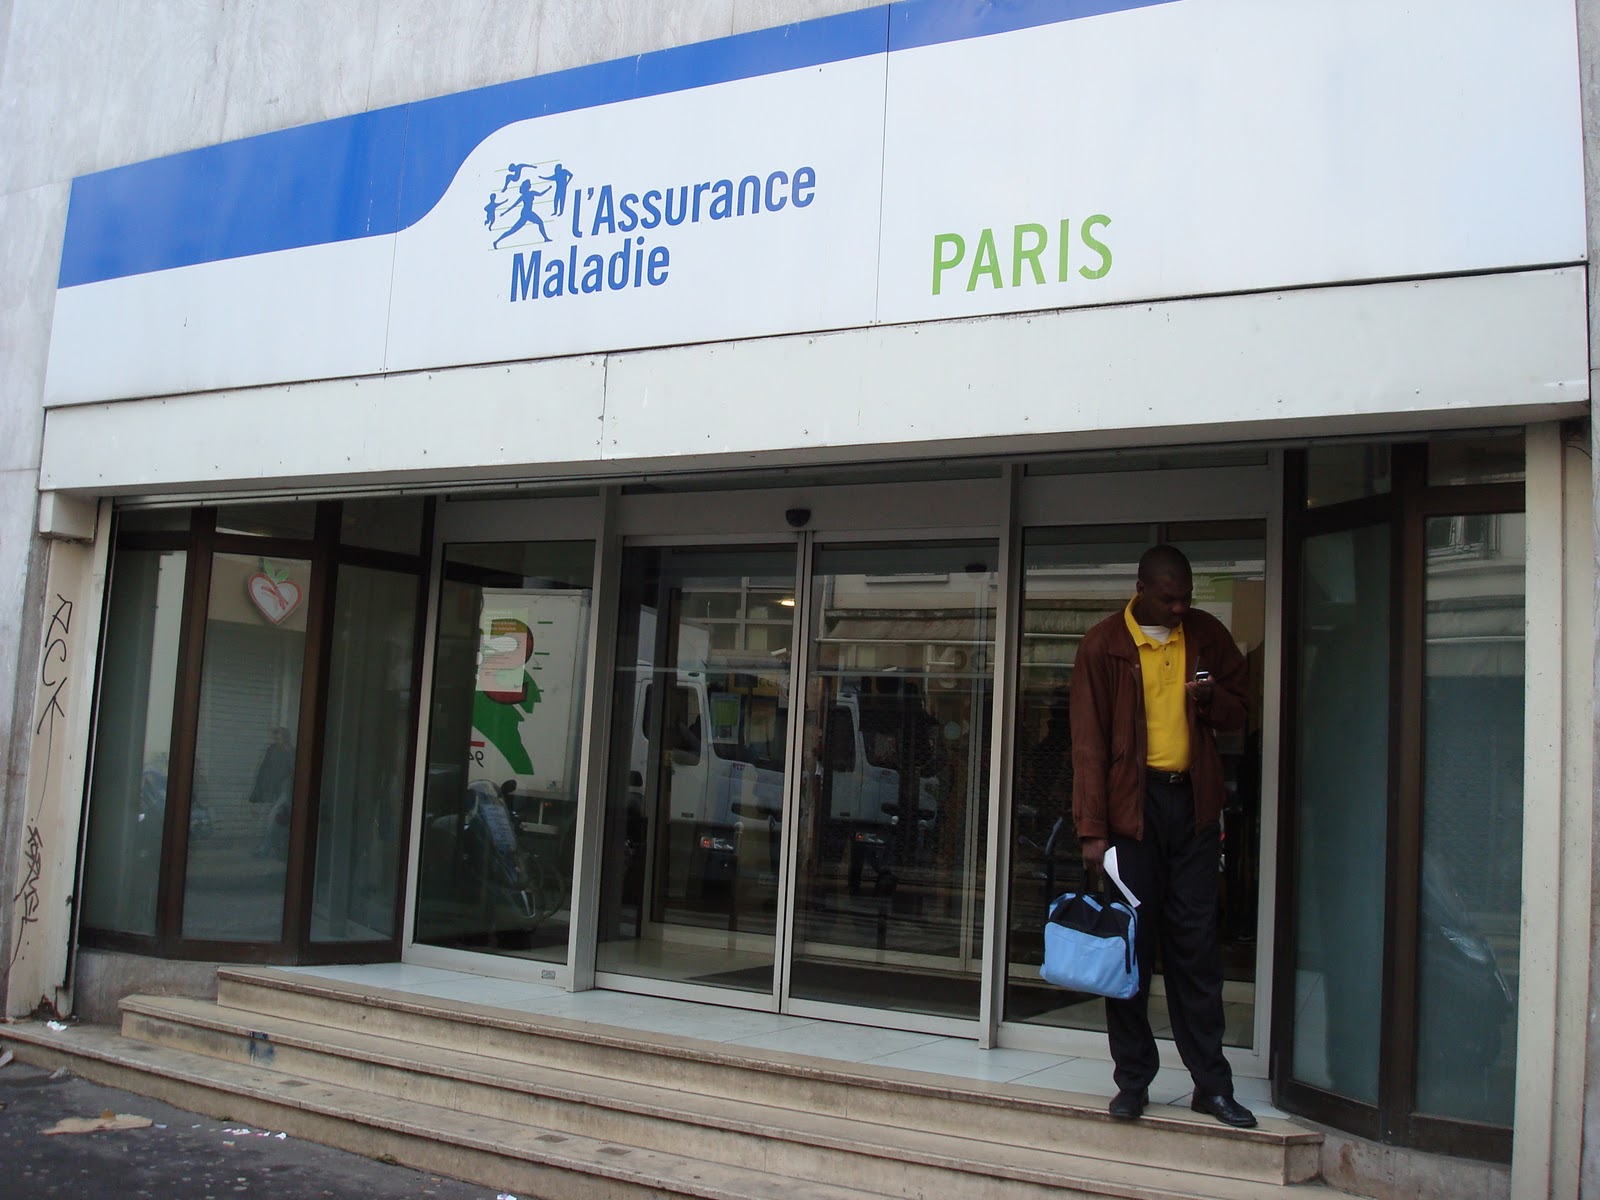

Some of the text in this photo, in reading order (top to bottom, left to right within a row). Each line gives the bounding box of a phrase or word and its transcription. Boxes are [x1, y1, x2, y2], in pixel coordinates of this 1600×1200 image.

[572, 166, 816, 238] l'Assurance
[510, 236, 670, 302] Maladie
[932, 214, 1113, 295] PARIS
